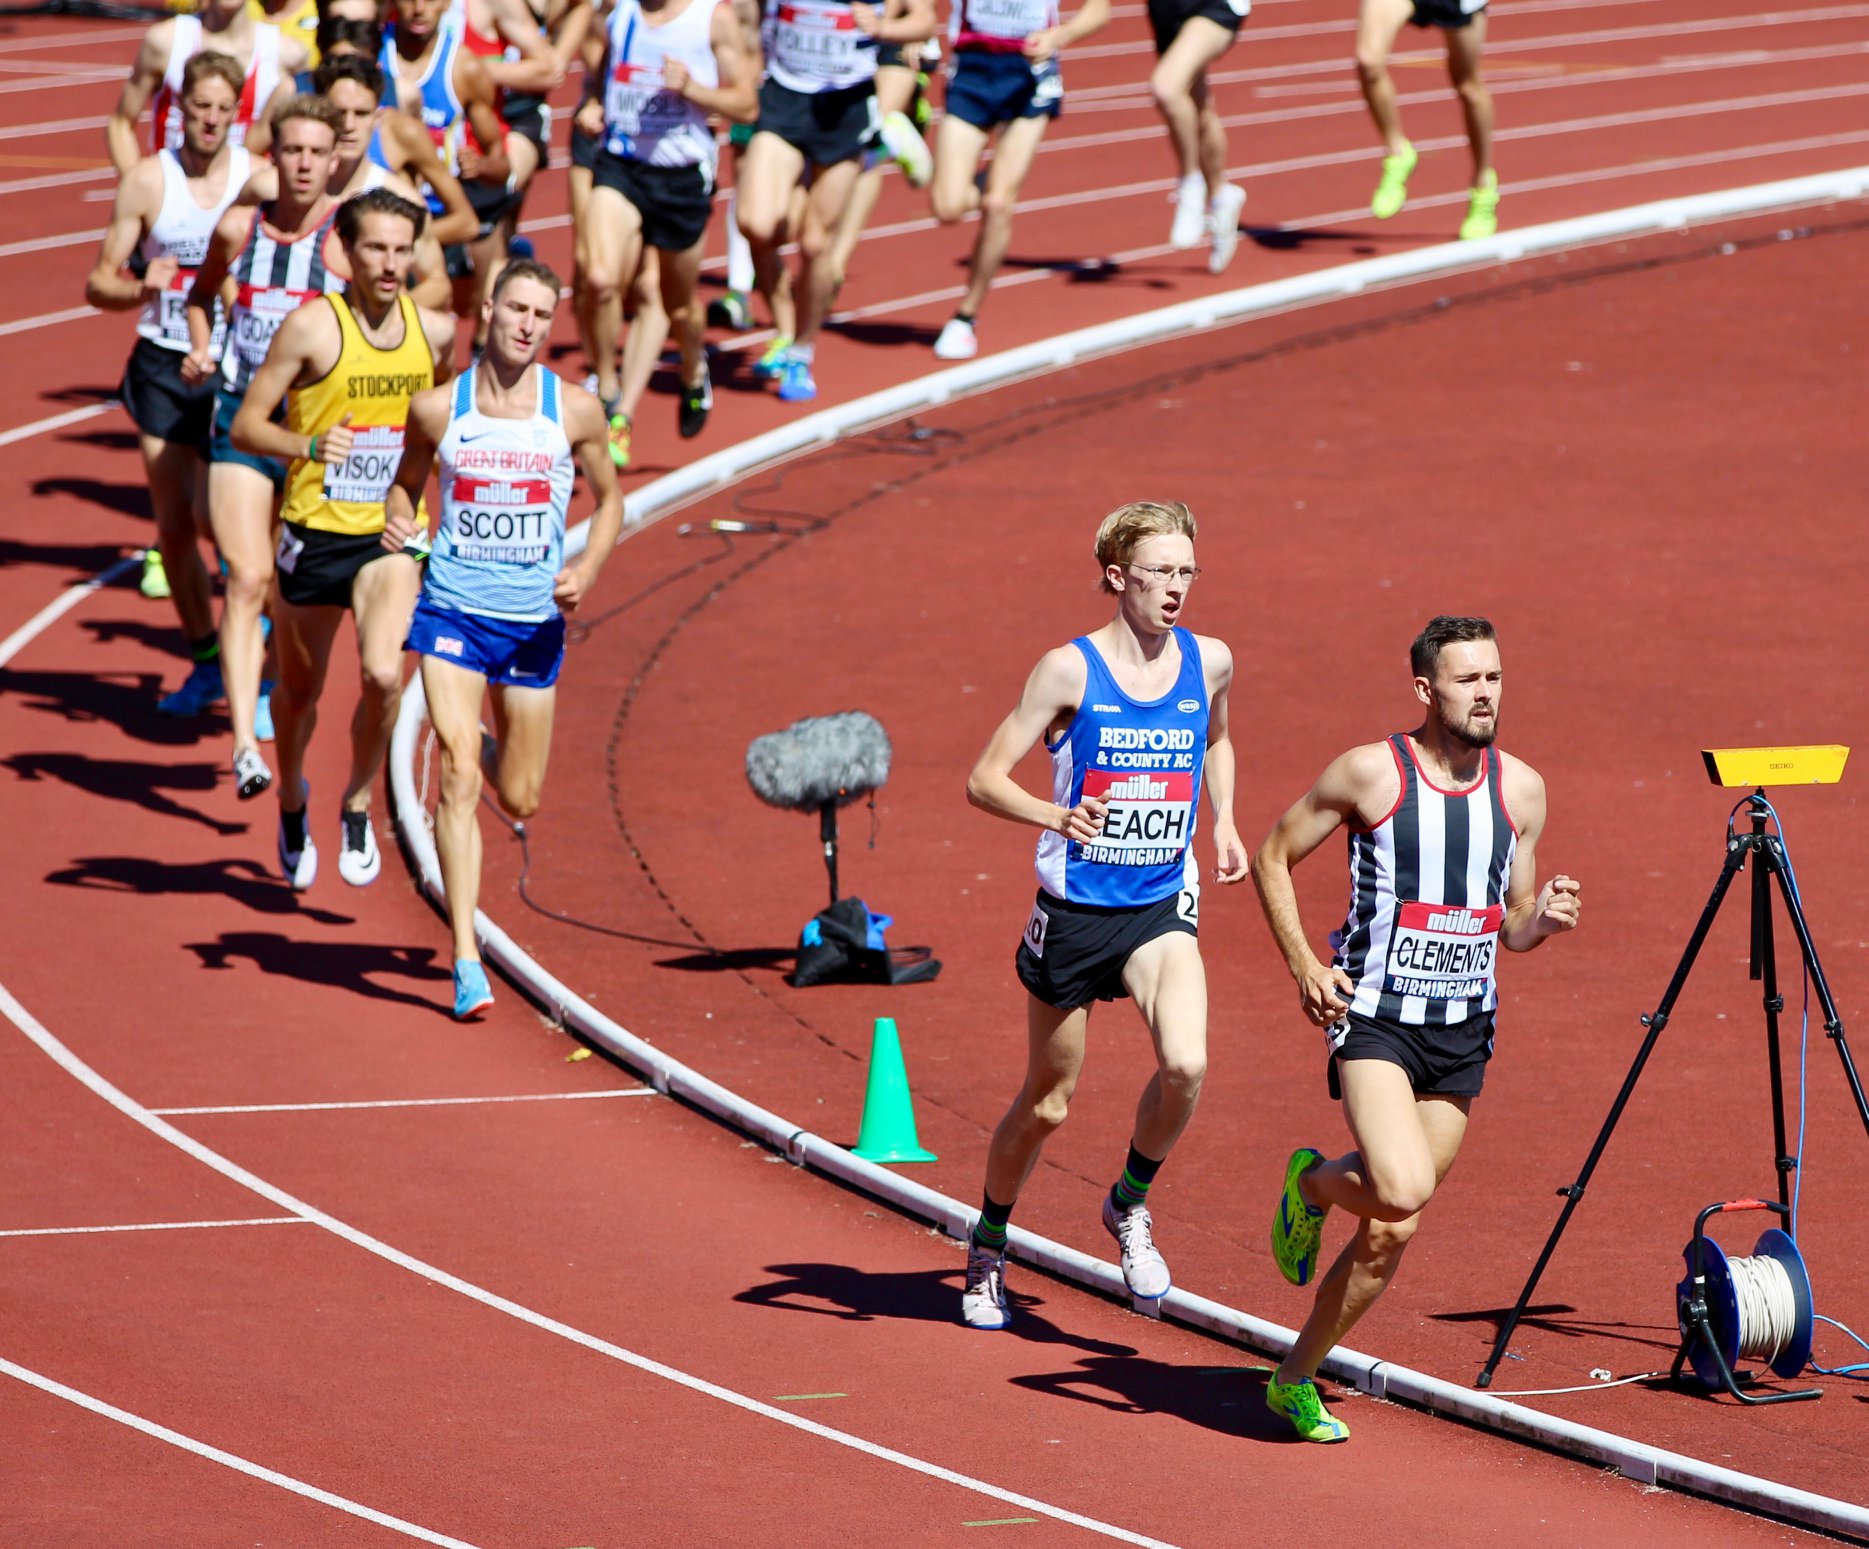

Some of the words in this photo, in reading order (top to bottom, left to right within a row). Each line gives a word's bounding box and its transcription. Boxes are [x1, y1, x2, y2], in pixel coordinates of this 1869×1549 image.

[347, 372, 427, 398] STOCKPORT
[455, 449, 498, 469] GREAT
[500, 450, 554, 472] BRITAIN
[458, 509, 547, 540] SCOTT
[457, 545, 545, 563] BIRMINGHAM
[1092, 703, 1122, 713] STRAVA
[1178, 702, 1199, 712] wasp
[1098, 727, 1195, 750] BEDFORD
[1096, 751, 1109, 766] &
[1111, 752, 1172, 768] COUNTY
[1173, 753, 1193, 768] AC
[1110, 774, 1169, 800] müller
[1098, 809, 1185, 840] EACH
[1082, 845, 1177, 867] BIRMINGHAM
[1426, 909, 1488, 934] müller
[1396, 936, 1493, 974] CLEMENTS
[1392, 976, 1484, 999] BIRMINGHAM
